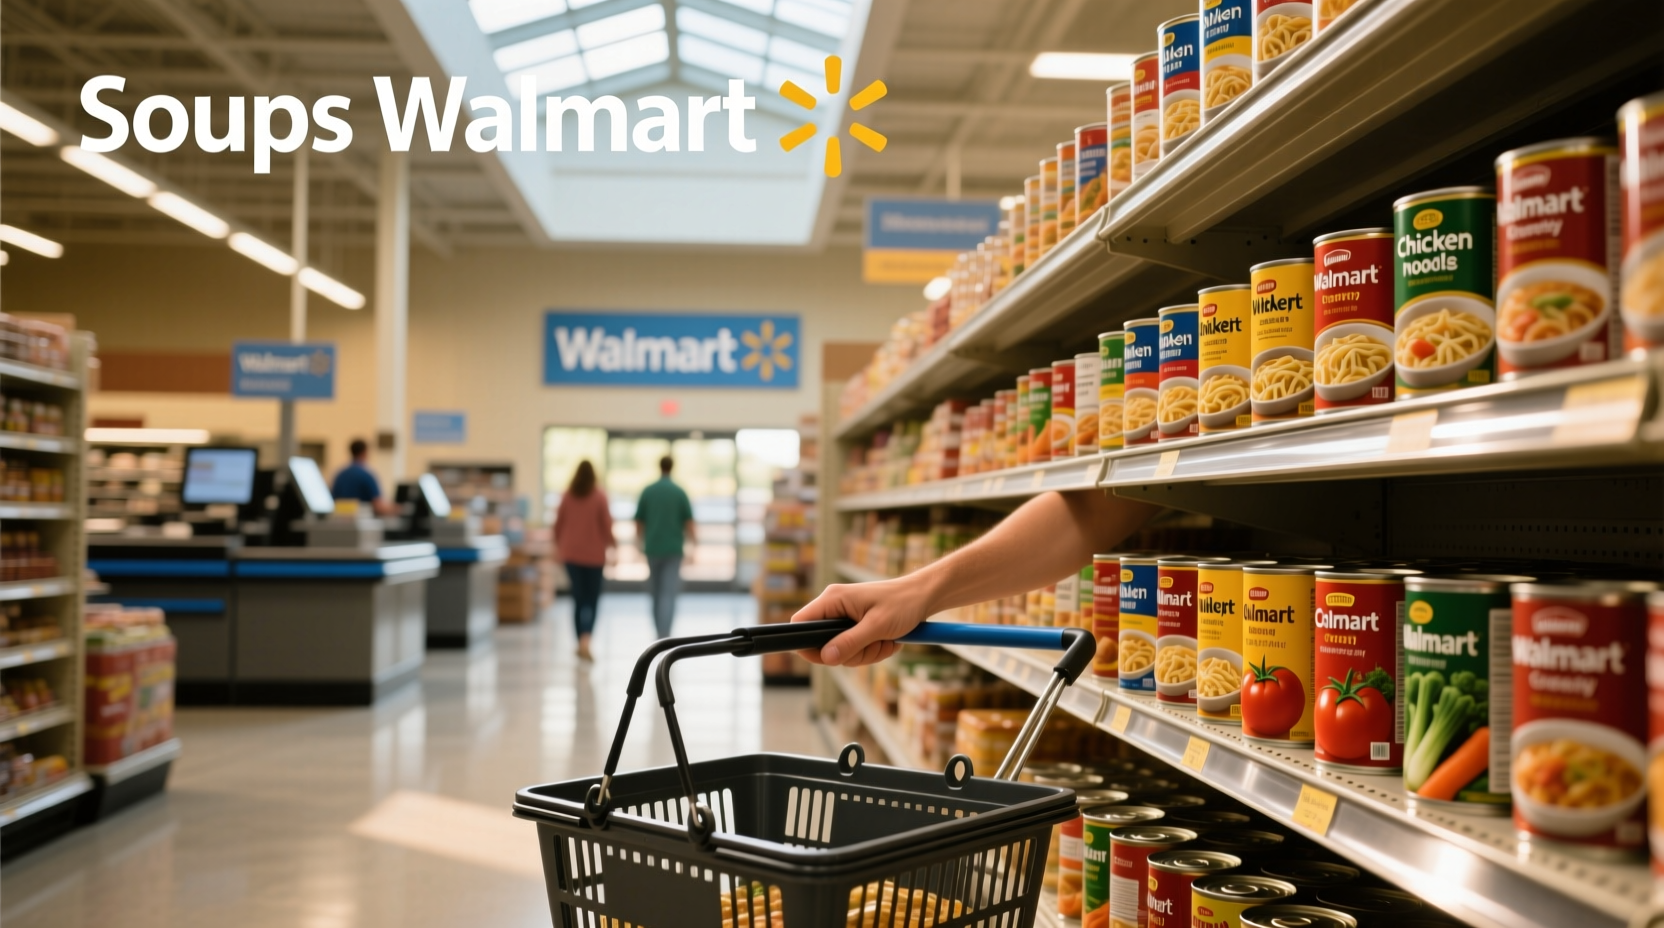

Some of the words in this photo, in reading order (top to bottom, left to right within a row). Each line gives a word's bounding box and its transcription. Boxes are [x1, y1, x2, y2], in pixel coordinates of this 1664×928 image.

[1397, 229, 1473, 258] Chicken
[1314, 264, 1379, 292] Walmart
[554, 326, 738, 374] Walmart
